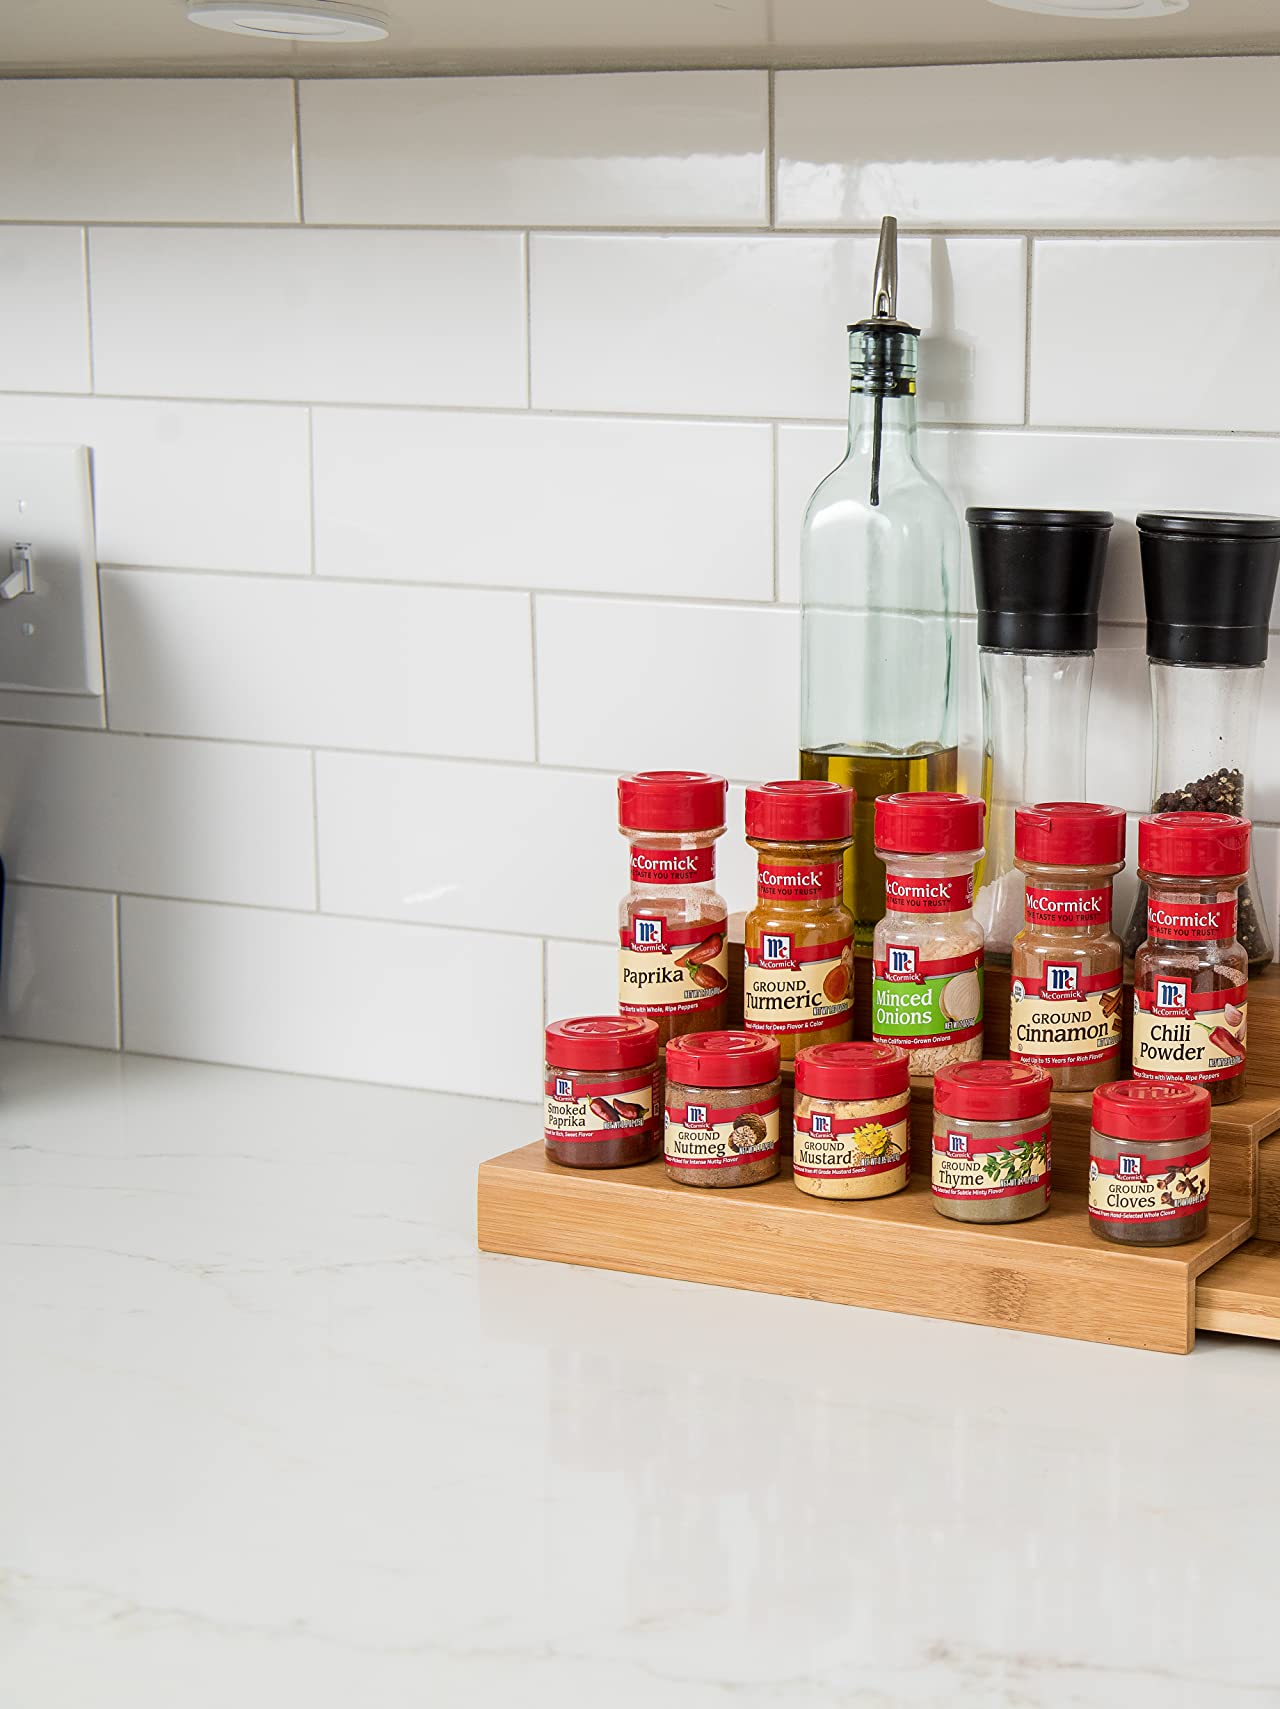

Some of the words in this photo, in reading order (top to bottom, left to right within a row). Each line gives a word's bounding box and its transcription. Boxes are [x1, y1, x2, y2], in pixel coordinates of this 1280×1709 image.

[671, 871, 693, 879] TRUST
[778, 888, 792, 896] YOU
[795, 888, 817, 896] TRUST
[906, 899, 921, 907] YOU
[924, 899, 947, 907] TRUST
[1026, 893, 1101, 912] McCormick
[1036, 912, 1055, 921] TASTE
[1058, 914, 1073, 922] YOU
[1076, 913, 1097, 921] TRUST
[1174, 928, 1189, 937] YOU
[1192, 928, 1215, 937] TRUST
[631, 943, 667, 952] McCormick
[760, 960, 797, 969] McCormick
[623, 967, 684, 989] Paprika
[885, 972, 921, 981] McCormick
[753, 980, 806, 993] GROUND
[746, 990, 823, 1010] Turmeric
[876, 988, 933, 1007] Minced
[1041, 990, 1082, 1000] McCormick
[665, 1005, 676, 1013] Ripe
[677, 1003, 699, 1011] Peppers
[1152, 1006, 1191, 1016] McCormick
[876, 1008, 933, 1025] Onions
[1032, 1010, 1092, 1025] GROUND
[1017, 1022, 1109, 1043] Cinnamon
[1150, 1024, 1191, 1042] Chili
[888, 1037, 931, 1045] California-Grown
[932, 1035, 951, 1043] Onions
[1140, 1041, 1206, 1061] Powder
[1089, 1053, 1104, 1061] Flavor
[1166, 1074, 1184, 1082] Whole,
[1185, 1074, 1197, 1082] Ripe
[1198, 1072, 1220, 1081] Peppers
[547, 1103, 586, 1116] Smoked
[548, 1115, 586, 1129] Paprika
[678, 1131, 720, 1141] GROUND
[674, 1140, 726, 1157] Nutmeg
[804, 1141, 845, 1152] GROUND
[800, 1149, 852, 1165] Mustard
[941, 1161, 981, 1172] GROUND
[939, 1170, 984, 1188] Thyme
[988, 1187, 1005, 1195] Flavor
[1108, 1184, 1155, 1194] GROUND
[1106, 1194, 1156, 1208] Cloves
